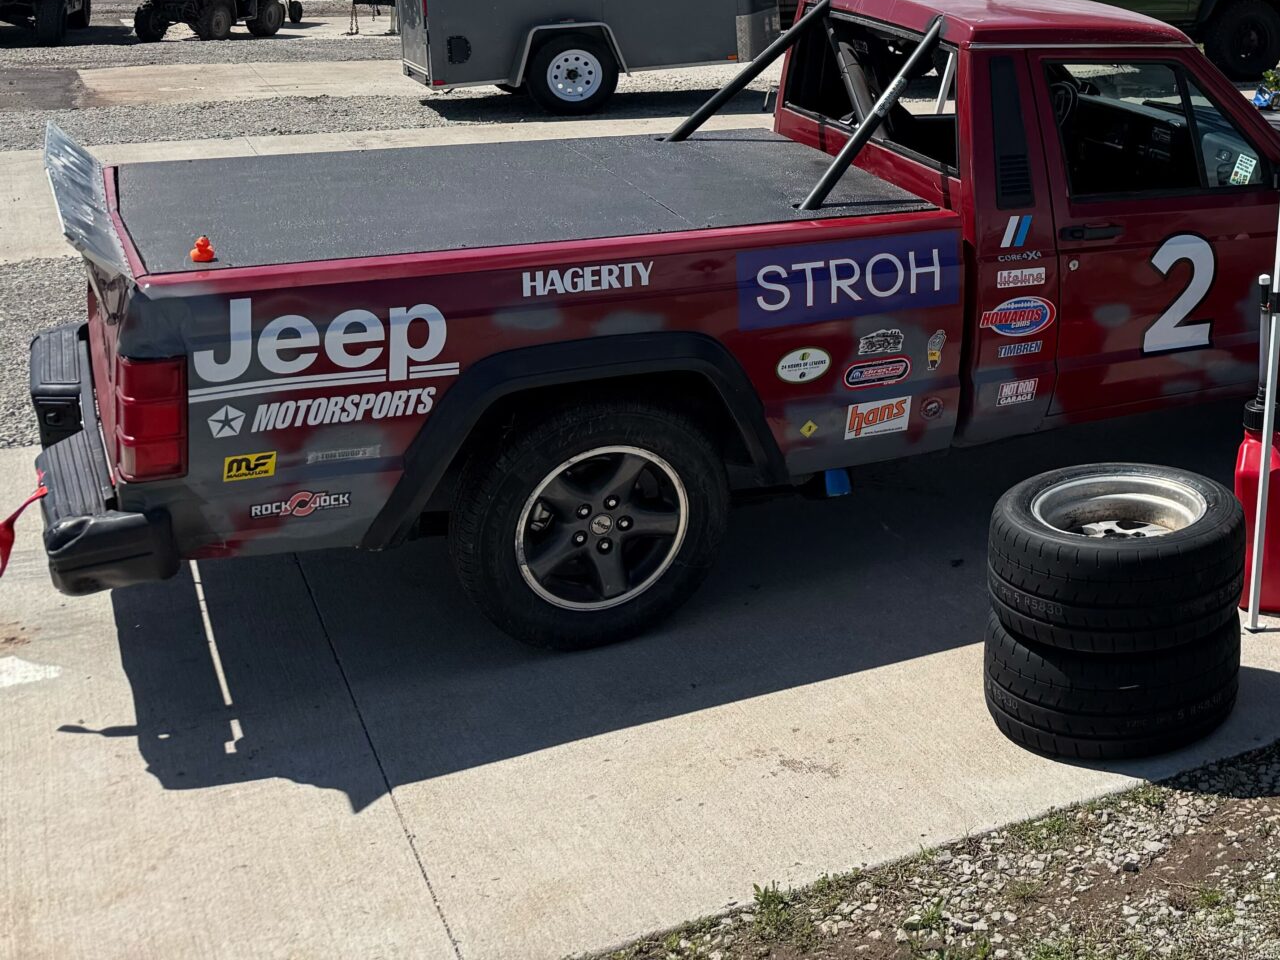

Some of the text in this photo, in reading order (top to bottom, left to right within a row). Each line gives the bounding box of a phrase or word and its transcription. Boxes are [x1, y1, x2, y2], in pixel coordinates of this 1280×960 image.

[522, 261, 654, 297] HAGERTY
[756, 248, 942, 312] STROH
[1142, 233, 1216, 354] 2
[980, 308, 1042, 328] HOWARDS
[193, 297, 448, 383] Jeep
[999, 342, 1041, 356] TIMBREN
[1002, 380, 1036, 397] HOT ROD
[1000, 393, 1033, 405] GARAGE
[251, 386, 437, 433] MOTORSPORTS
[848, 399, 907, 437] hans
[251, 501, 292, 517] ROCK
[311, 492, 350, 508] JOCK
[594, 519, 609, 530] Jeep
